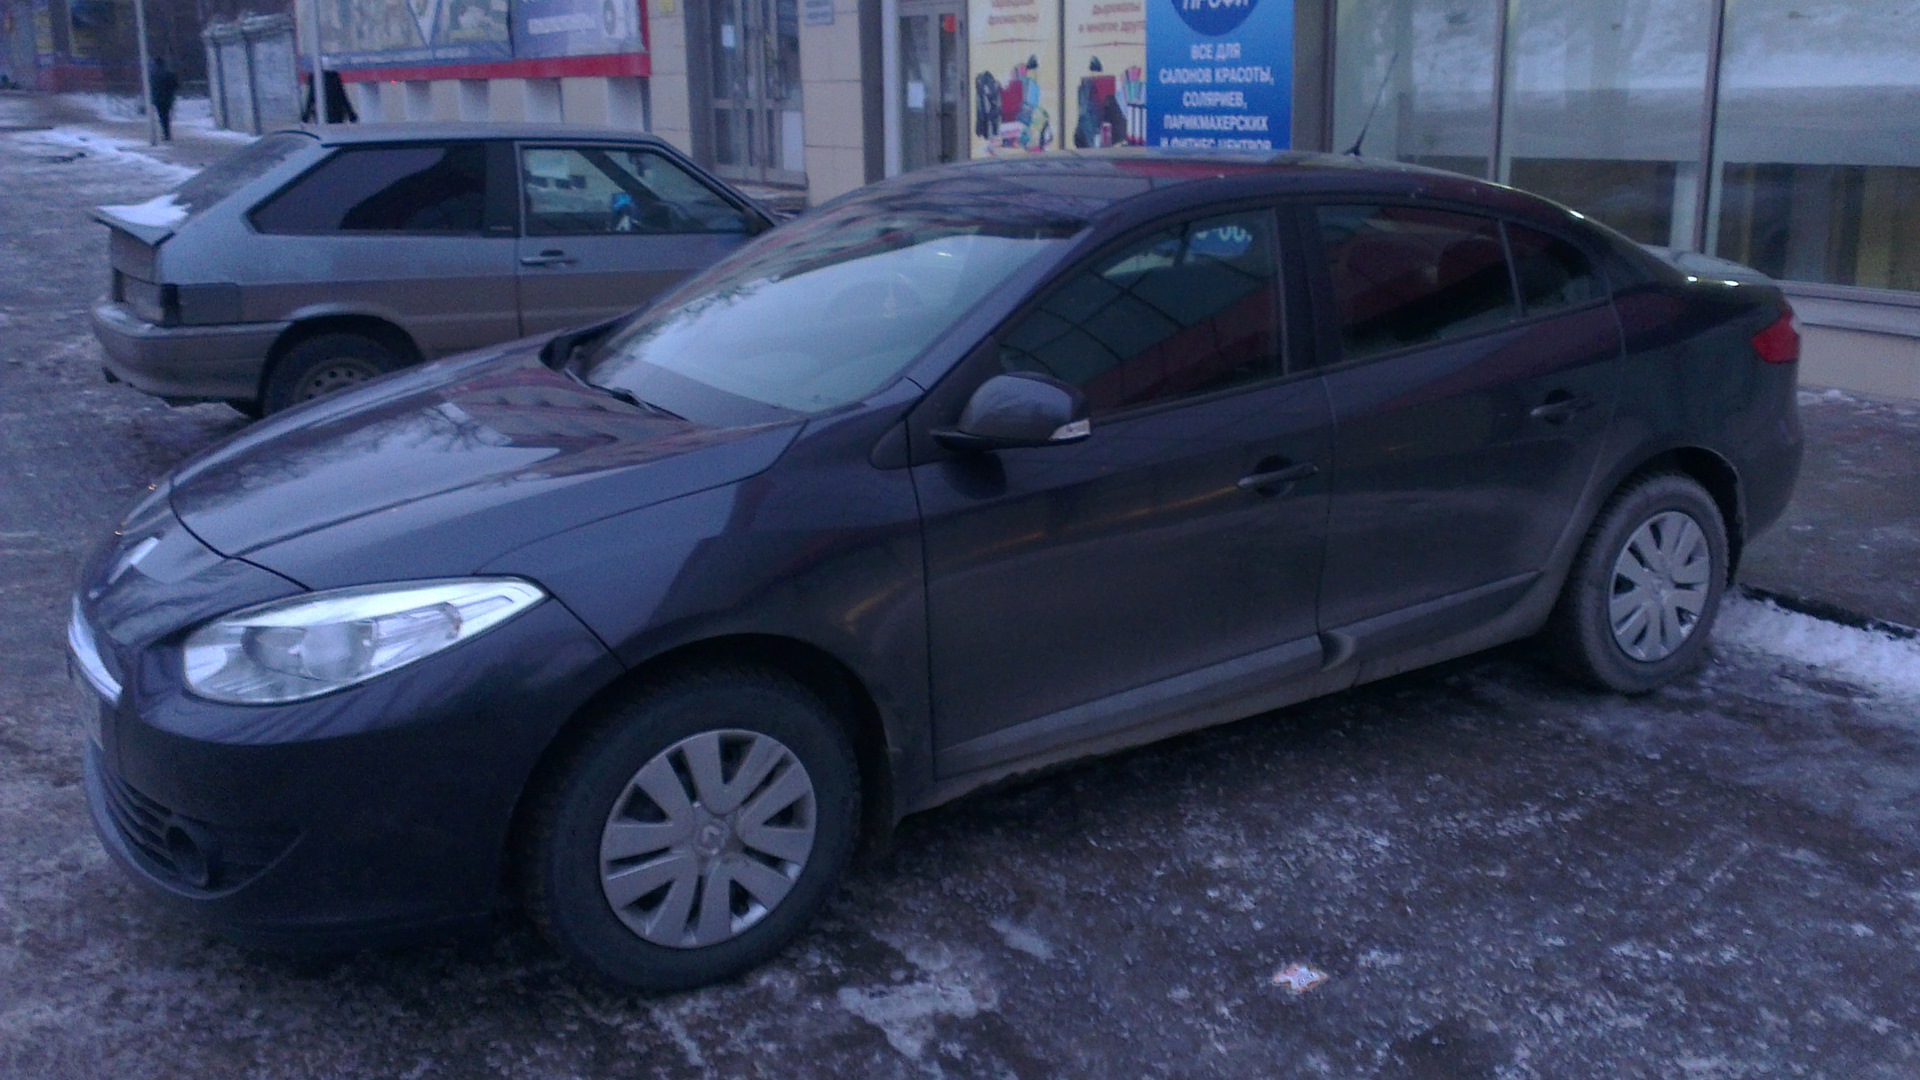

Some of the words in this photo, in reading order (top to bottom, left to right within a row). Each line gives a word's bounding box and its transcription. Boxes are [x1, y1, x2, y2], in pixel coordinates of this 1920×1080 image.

[1191, 43, 1213, 60] ВСЕ
[1214, 42, 1241, 61] ДЛЯ
[1159, 67, 1212, 84] САЛОНОВ
[1214, 66, 1274, 85] КРАСОТЫ,
[1163, 114, 1268, 131] ПАРИКМАХЕРСКИХ
